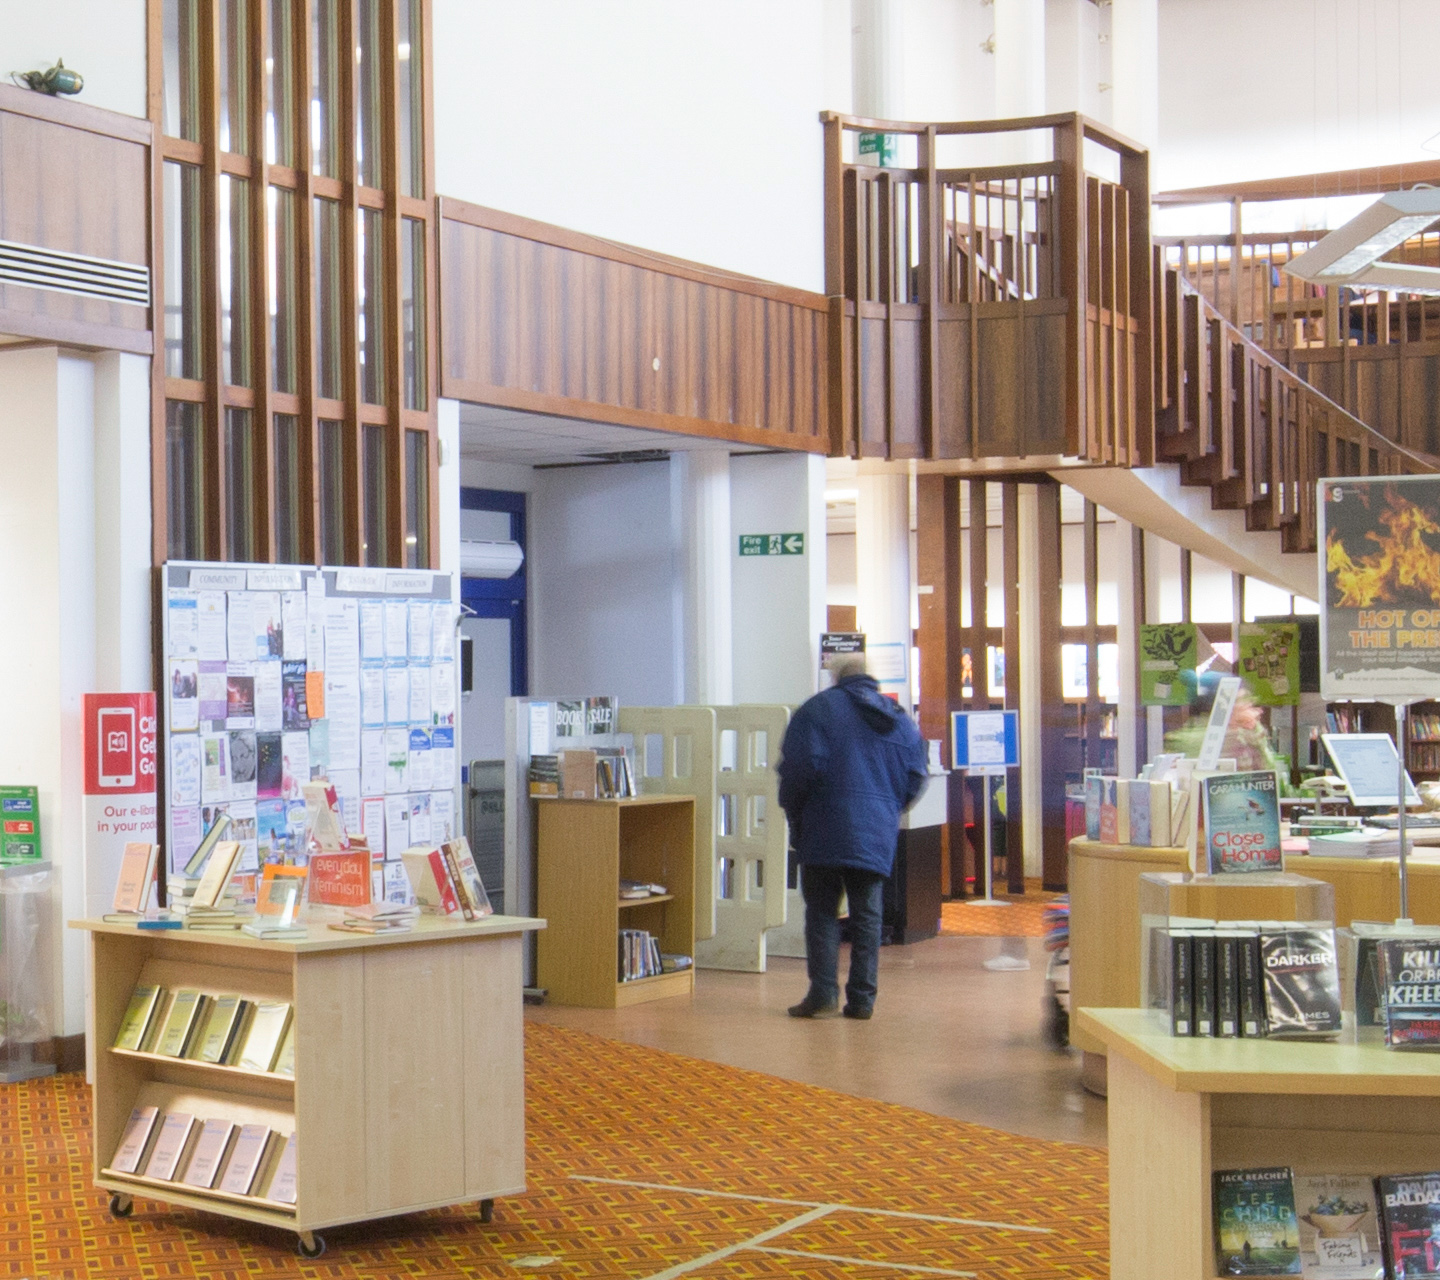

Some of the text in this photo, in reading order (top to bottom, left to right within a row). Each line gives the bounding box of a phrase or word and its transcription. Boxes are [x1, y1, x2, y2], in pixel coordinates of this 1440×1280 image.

[743, 536, 761, 544] Fire
[743, 545, 761, 554] exit
[1358, 609, 1406, 628] HOT
[1349, 630, 1390, 648] THE
[557, 708, 612, 725] BOOK SALE
[1209, 780, 1275, 795] CARA HUNTER
[105, 806, 127, 817] Our
[97, 821, 137, 834] in your
[1213, 831, 1264, 847] Close
[1222, 847, 1281, 864] Home
[316, 859, 363, 876] everyday
[312, 875, 363, 896] feminism
[1267, 951, 1334, 968] DARKER
[1221, 1172, 1289, 1183] JACK REACHER
[1237, 1192, 1275, 1206] LEE
[1223, 1205, 1291, 1221] CHILD
